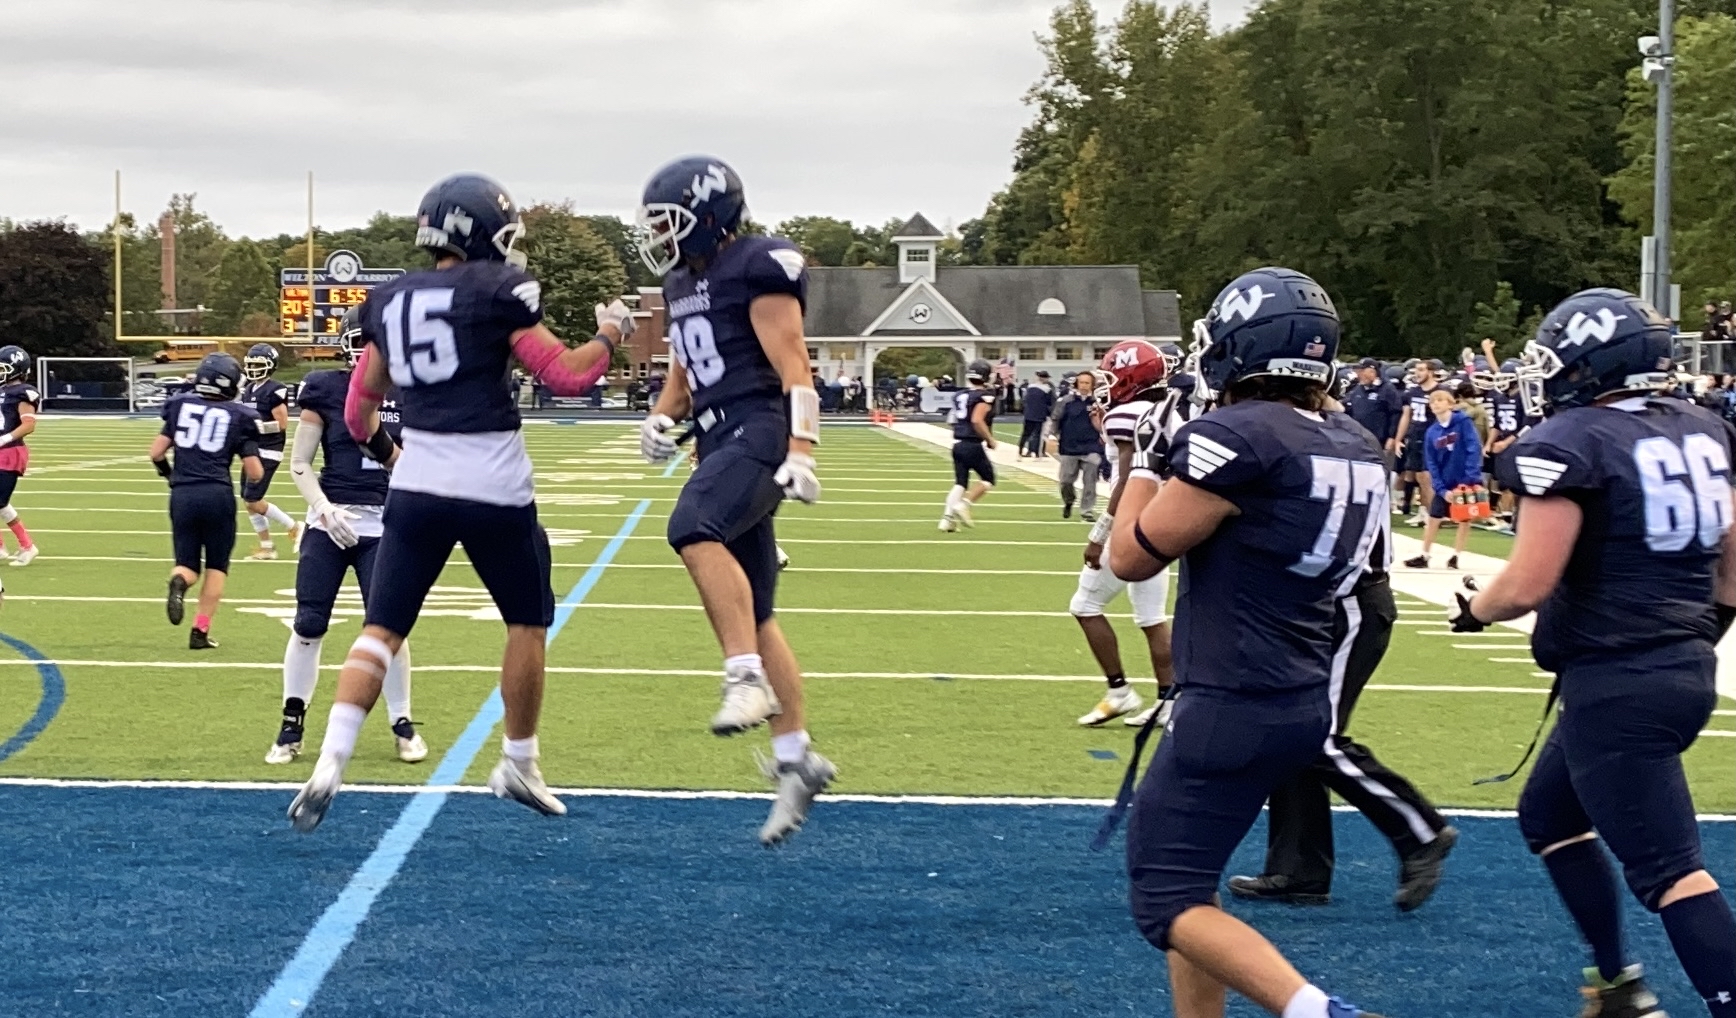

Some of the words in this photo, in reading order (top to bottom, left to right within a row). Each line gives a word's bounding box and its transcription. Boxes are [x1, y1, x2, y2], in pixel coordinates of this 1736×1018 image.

[329, 289, 367, 304] 6:55
[282, 301, 303, 315] 20
[283, 319, 294, 333] 3
[326, 318, 337, 333] 3
[382, 287, 459, 387] 15
[1114, 347, 1139, 369] M
[174, 402, 231, 453] 50
[1632, 432, 1735, 553] 66
[1286, 455, 1386, 581] 77
